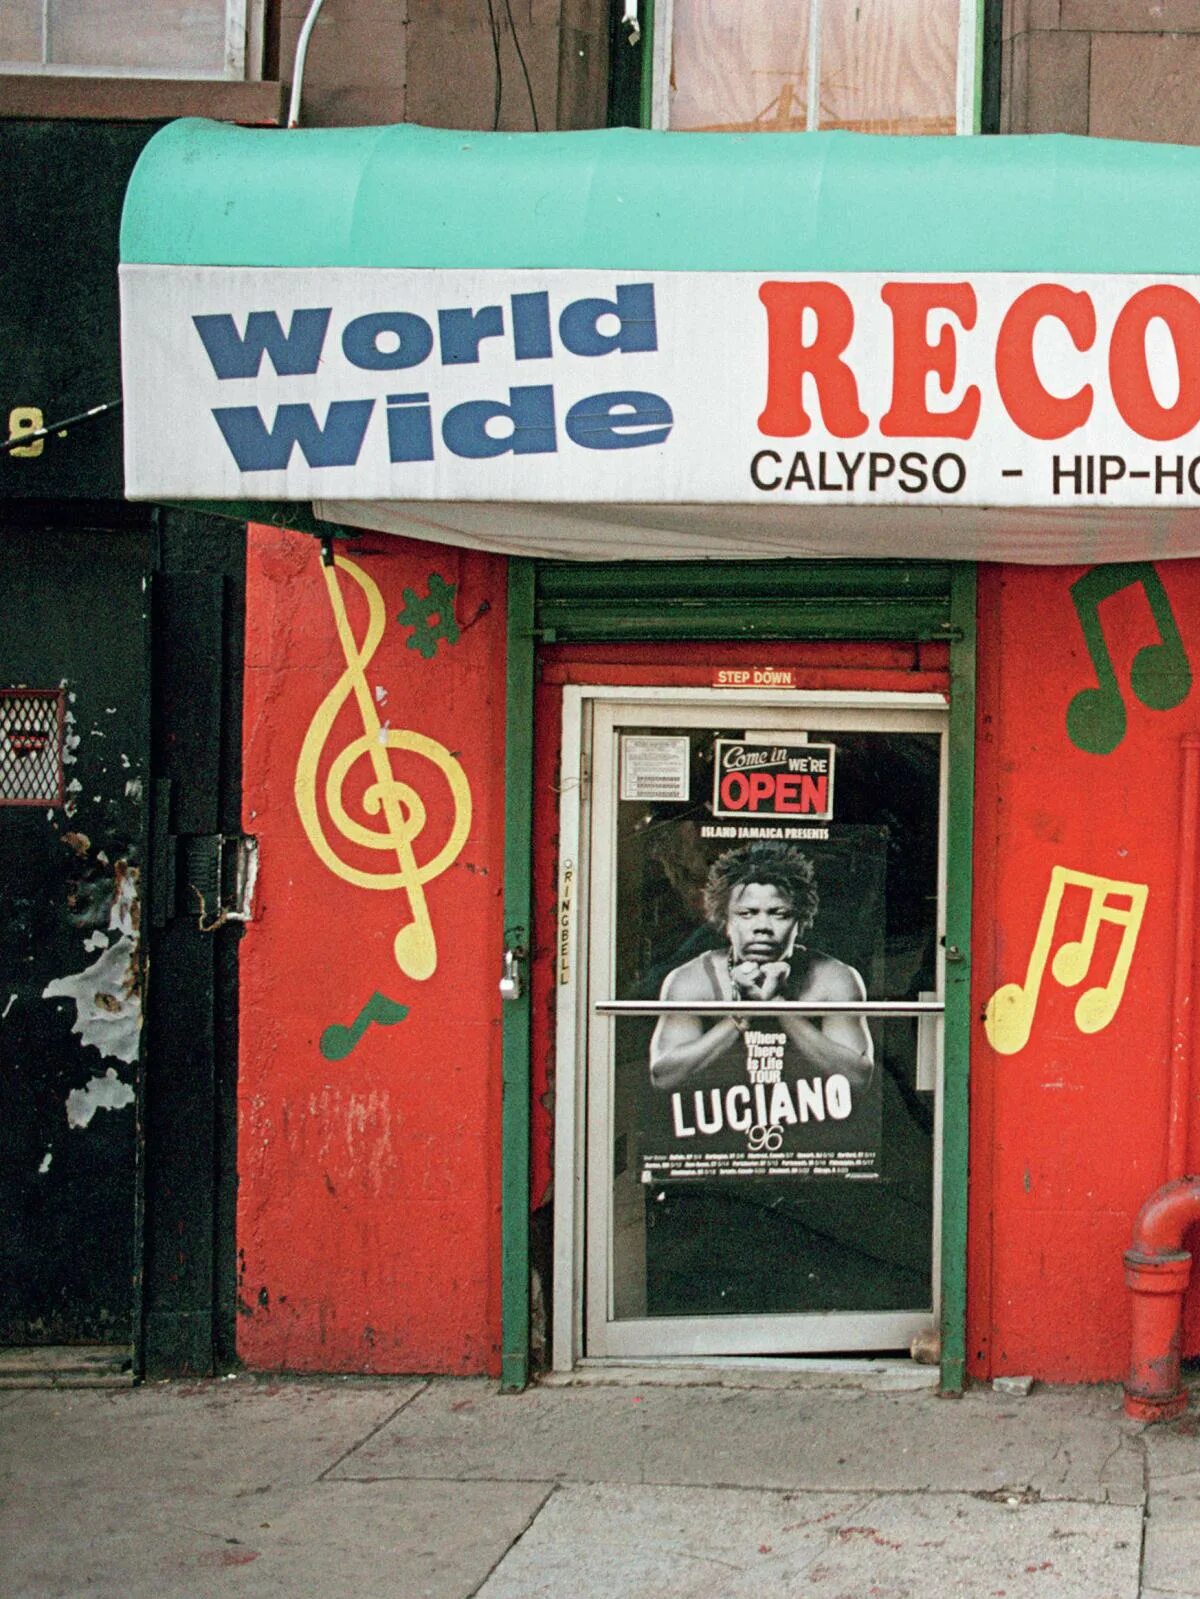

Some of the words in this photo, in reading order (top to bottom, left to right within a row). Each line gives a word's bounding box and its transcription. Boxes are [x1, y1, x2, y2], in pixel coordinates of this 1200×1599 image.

[192, 282, 658, 380] World
[212, 385, 673, 472] Wide
[750, 449, 967, 494] CALYPSO
[718, 671, 750, 684] STEP
[753, 671, 792, 684] DOWN
[723, 746, 768, 769] Come
[771, 747, 788, 763] in
[788, 756, 828, 773] WE'RE
[720, 771, 828, 813] OPEN
[701, 826, 737, 838] ISLAND
[738, 827, 784, 839] JAMAICA
[784, 828, 829, 840] PRESENTS
[744, 1030, 787, 1045] Where
[746, 1044, 785, 1058] There
[749, 1070, 781, 1083] TOUR
[672, 1073, 852, 1138] LUCIANO
